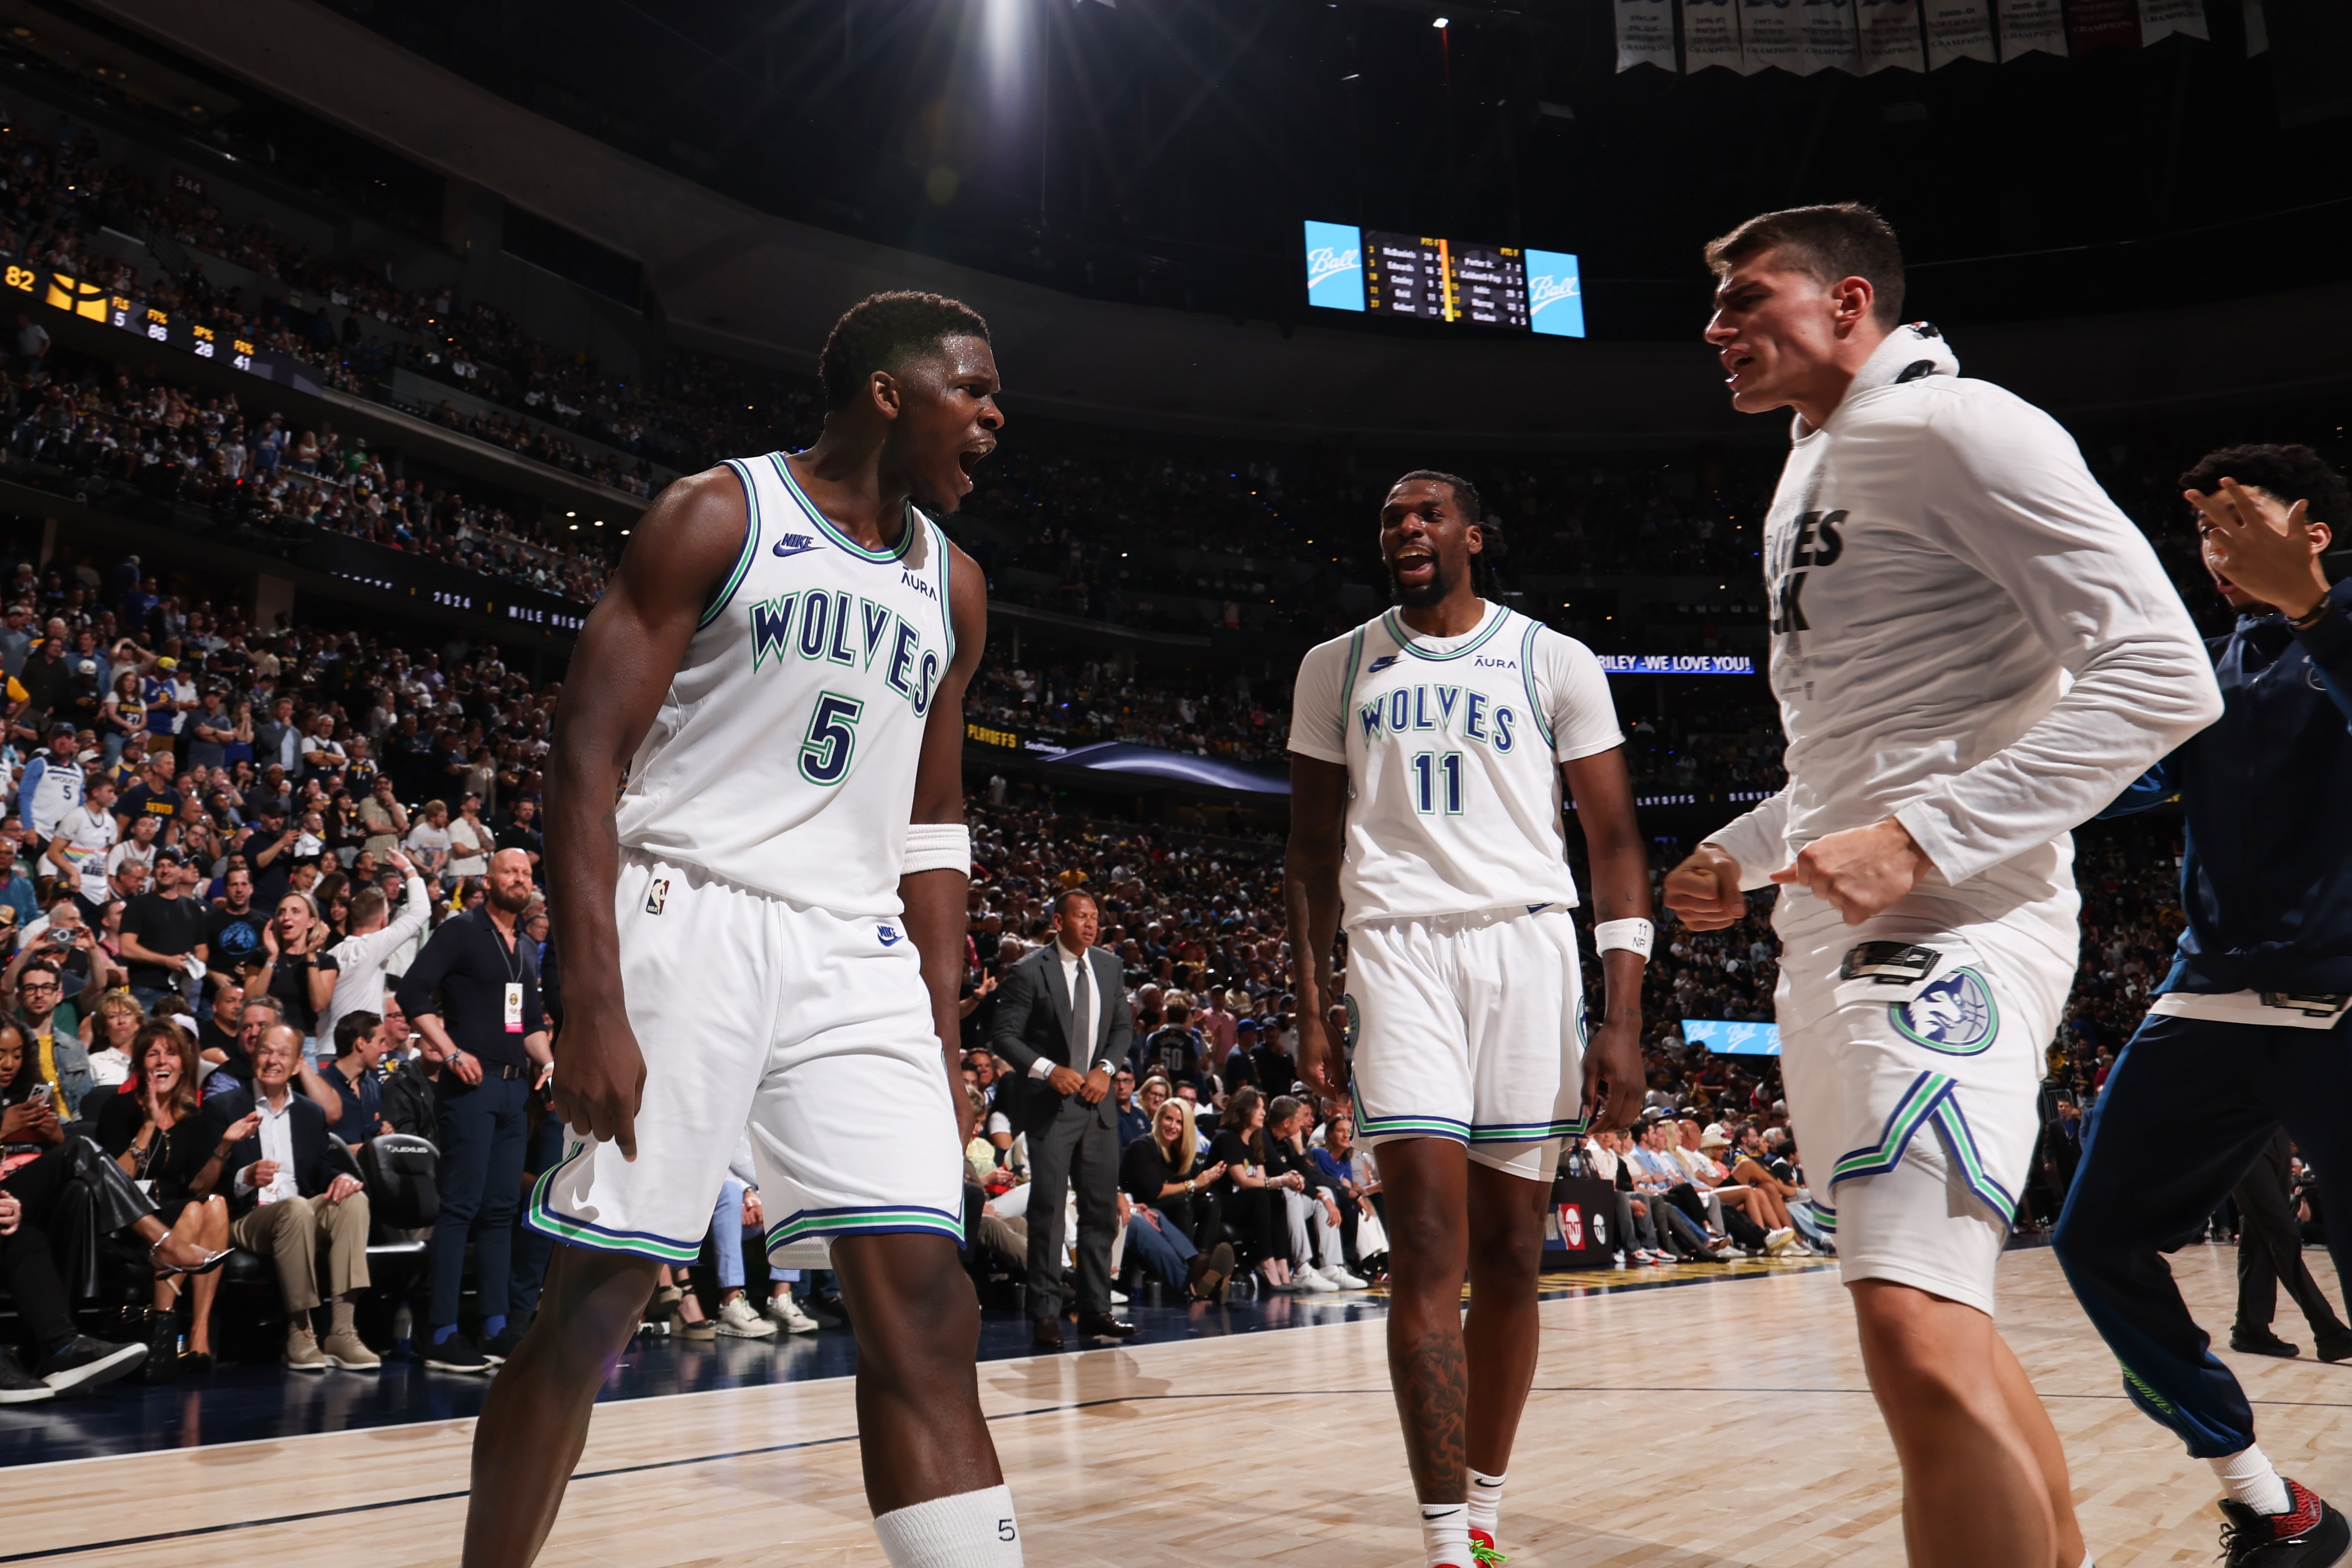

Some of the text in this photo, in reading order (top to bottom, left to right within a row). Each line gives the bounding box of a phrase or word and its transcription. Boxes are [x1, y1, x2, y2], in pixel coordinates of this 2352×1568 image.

[176, 175, 202, 194] 344
[1308, 248, 1361, 279] Ball
[5, 265, 35, 291] 82
[1529, 276, 1580, 307] Ball
[113, 312, 126, 327] 5
[147, 309, 168, 325] FT%
[147, 324, 168, 341] 86
[194, 340, 214, 358] 28
[233, 355, 251, 371] 41
[781, 533, 813, 548] NIKE
[508, 606, 543, 623] MILE
[749, 589, 939, 718] WOLVES
[1673, 656, 1710, 671] LOVE
[1712, 656, 1750, 671] YOU!
[1359, 683, 1517, 754] WOLVES
[798, 690, 865, 786] 5
[968, 724, 1017, 748] PLAYOFFS
[1411, 751, 1464, 816] 11
[63, 786, 72, 800] 5
[1637, 795, 1696, 806] LAYOFFS
[647, 905, 658, 913] NBA
[877, 925, 895, 938] NIKE
[1639, 923, 1647, 937] 11
[1632, 937, 1646, 949] NR
[1687, 1021, 1716, 1042] Ball
[1726, 1023, 1757, 1047] Ball
[1160, 1047, 1183, 1071] 50
[998, 1518, 1016, 1541] 5
